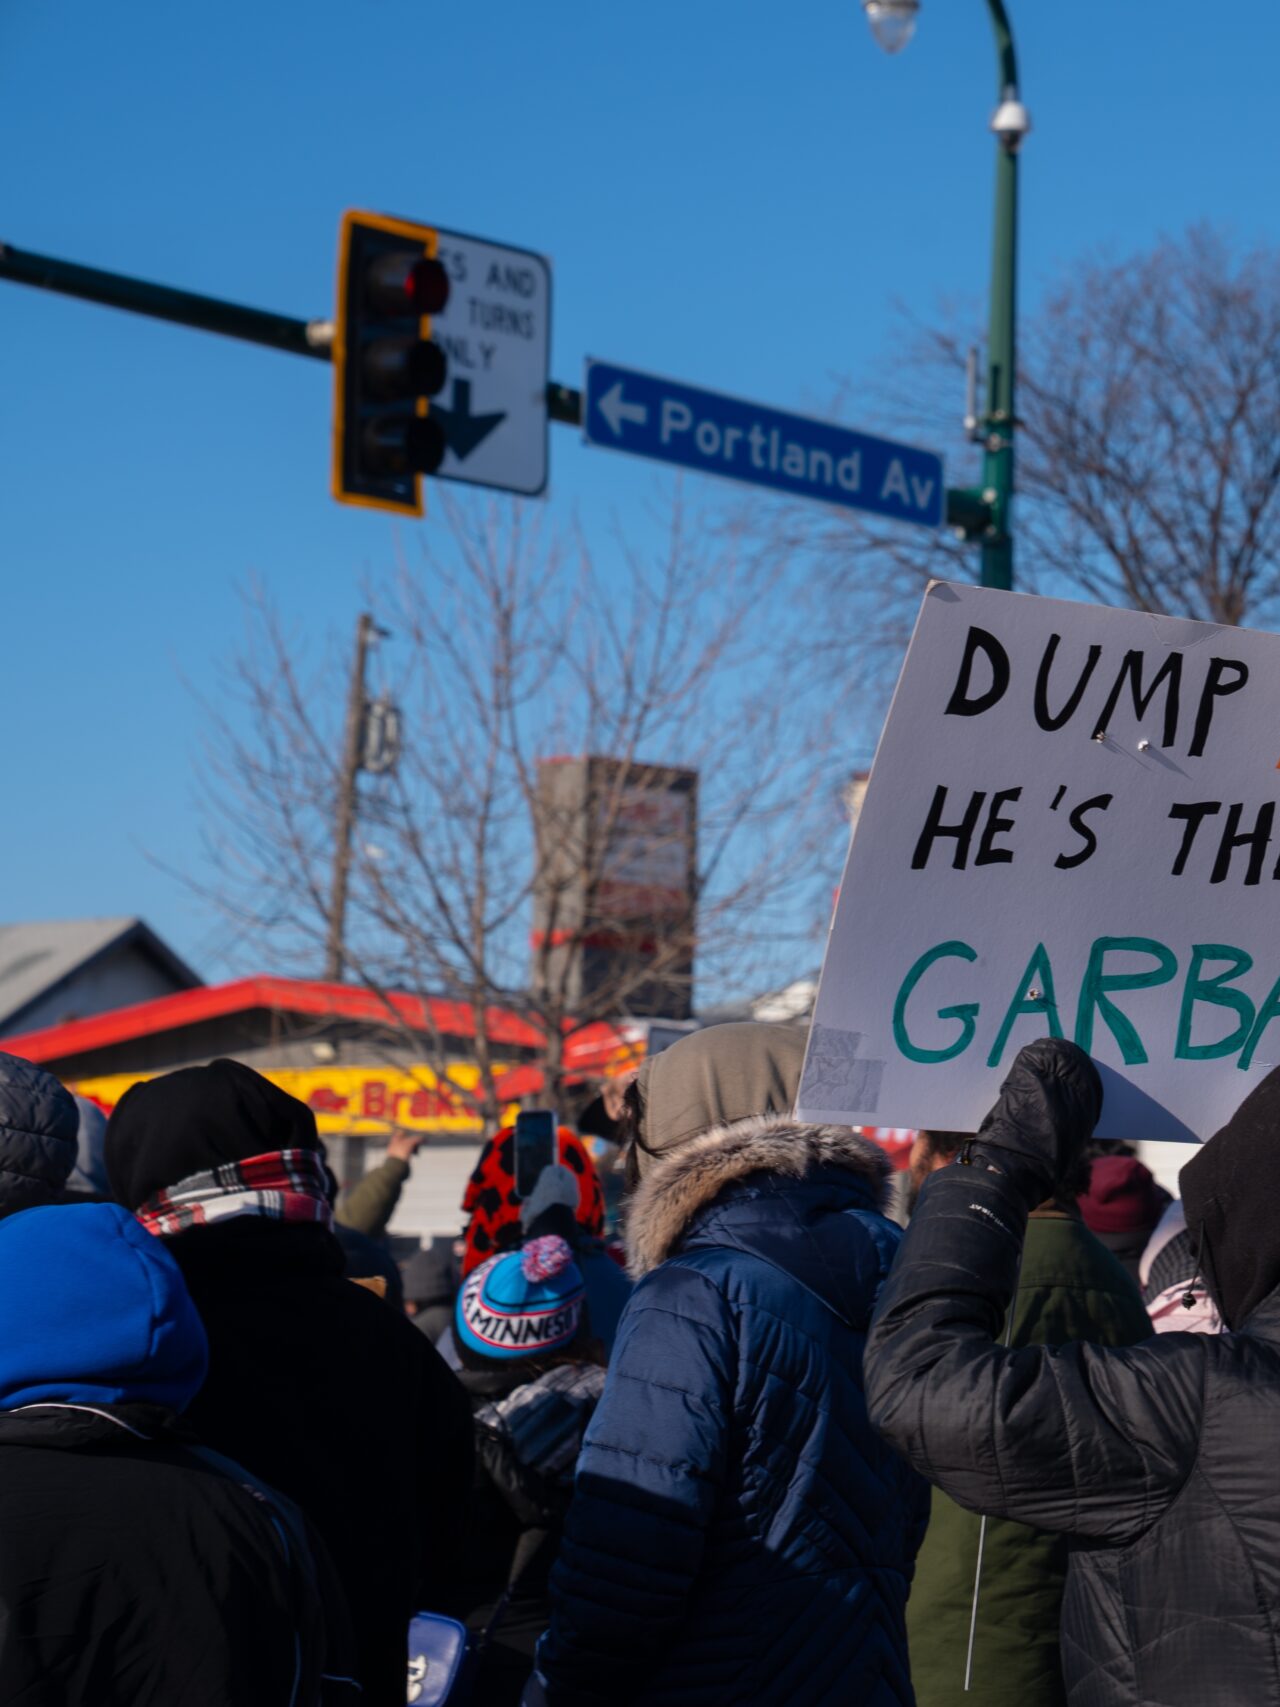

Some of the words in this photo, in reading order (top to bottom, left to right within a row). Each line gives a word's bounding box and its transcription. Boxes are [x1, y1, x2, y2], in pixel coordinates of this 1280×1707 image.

[486, 261, 536, 299] AND
[468, 296, 535, 340] TURNS
[434, 331, 496, 371] NLY
[660, 399, 861, 492] Portland
[881, 458, 934, 509] Av
[944, 625, 1250, 757] DUMP
[911, 785, 1114, 871] HE'S
